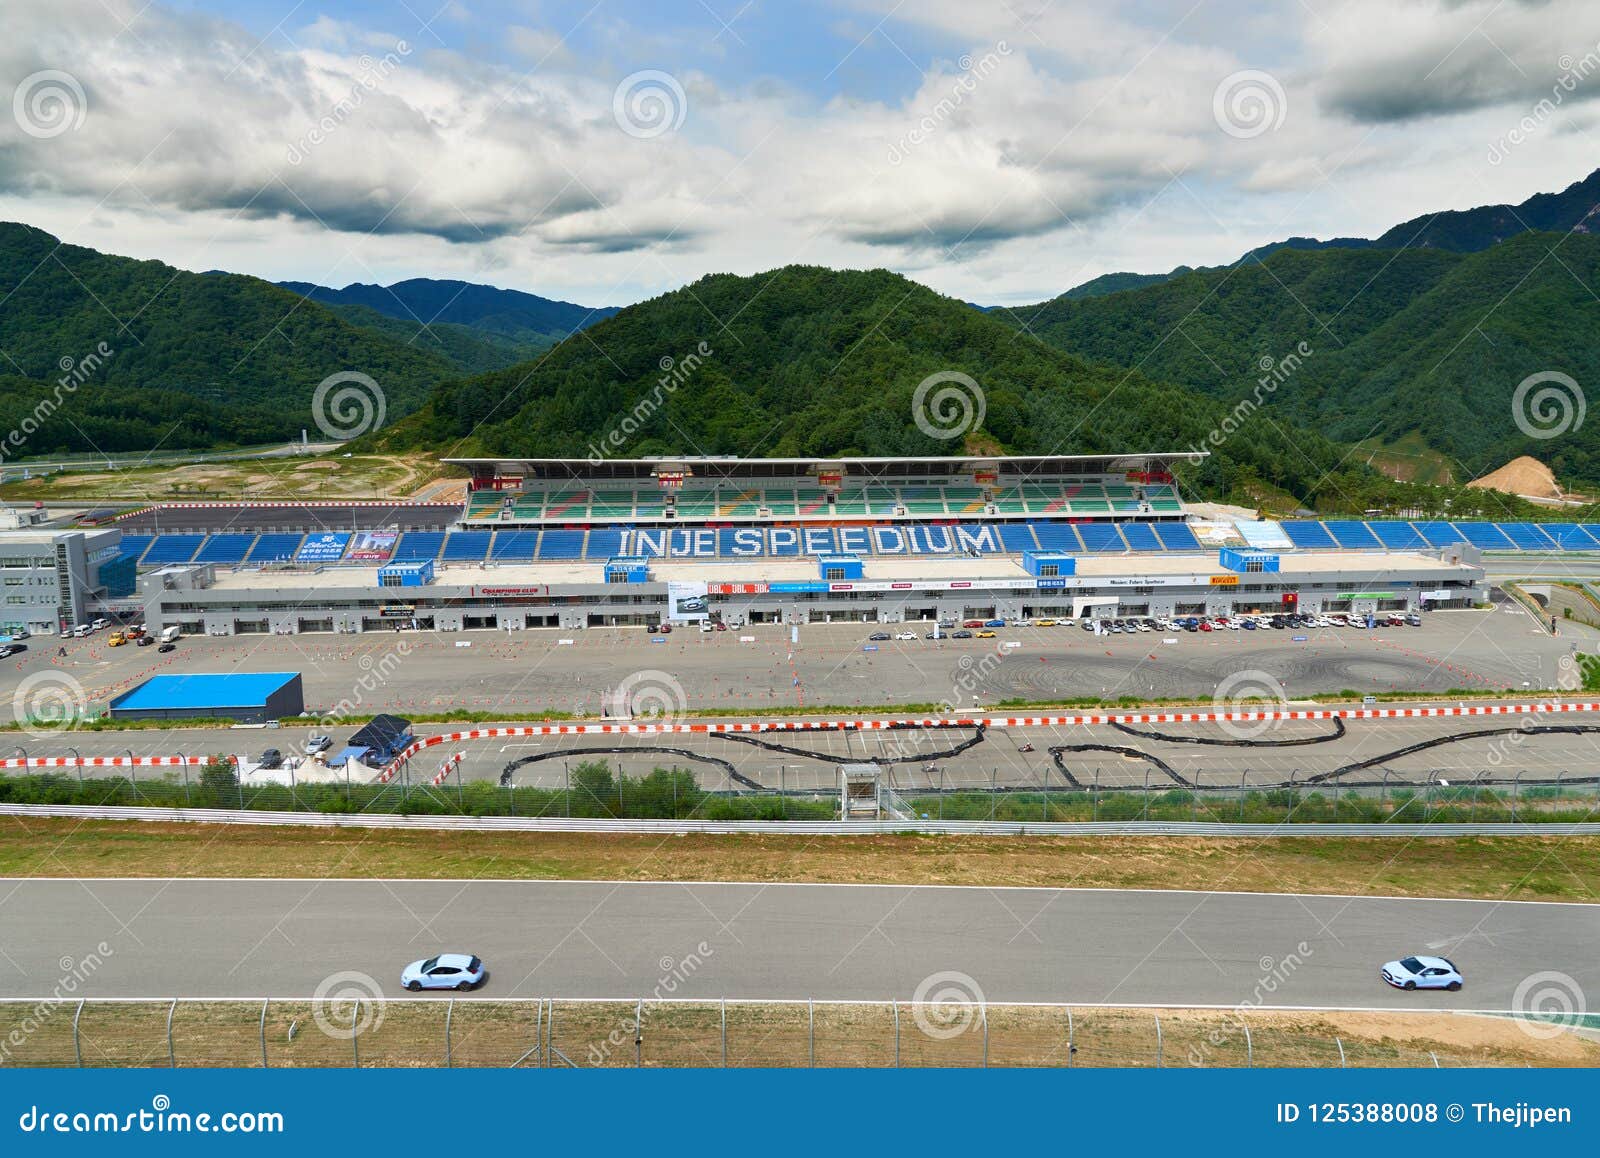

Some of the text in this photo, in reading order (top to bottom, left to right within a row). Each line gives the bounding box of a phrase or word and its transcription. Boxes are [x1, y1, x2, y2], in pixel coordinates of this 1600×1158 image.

[619, 525, 997, 557] INJE SPEEDIUM
[709, 584, 723, 594] JBL
[732, 584, 746, 593] JBL
